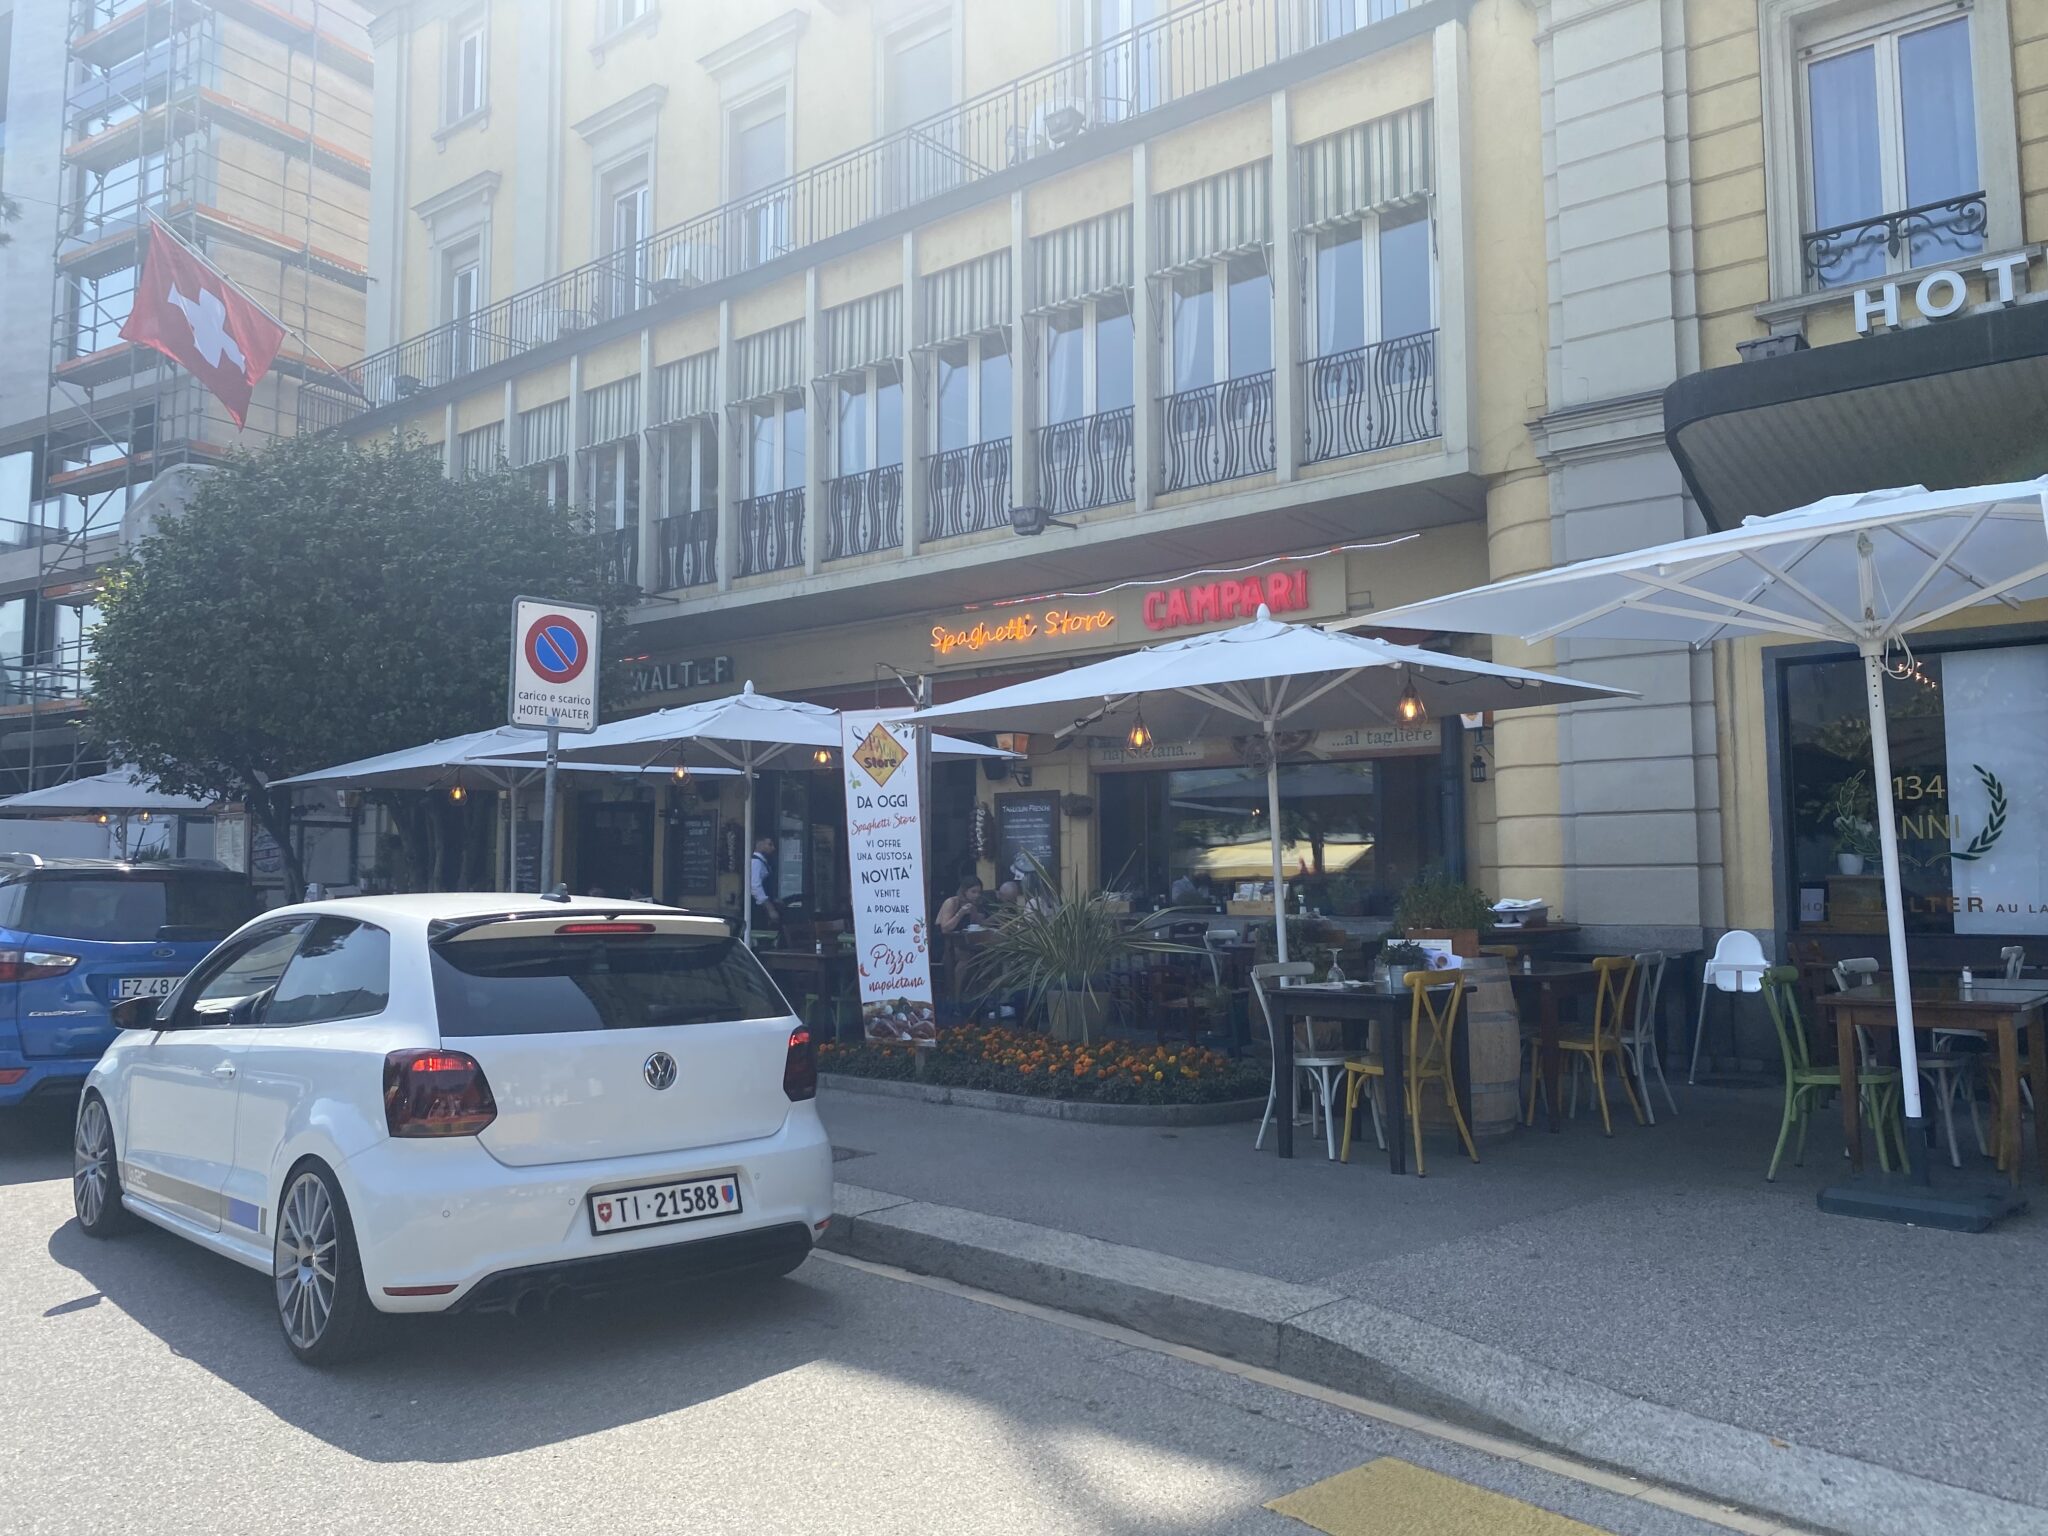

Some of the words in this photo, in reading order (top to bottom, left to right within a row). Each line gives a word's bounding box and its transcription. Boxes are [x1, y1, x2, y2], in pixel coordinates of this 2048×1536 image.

[1854, 248, 2048, 335] HOT
[1143, 569, 1309, 631] CAMPARI
[930, 613, 1037, 654] Spaghetti
[1044, 609, 1115, 635] Store
[518, 691, 547, 702] carico
[549, 694, 556, 703] e
[558, 695, 591, 705] scarico
[519, 705, 549, 716] HOTEL
[551, 707, 589, 719] WALTER
[1366, 727, 1433, 746] tagliere
[863, 756, 897, 769] Store
[1893, 775, 1946, 800] 134
[857, 795, 873, 808] DA
[877, 794, 908, 808] OGGI
[851, 818, 891, 836] Spaghetti
[892, 812, 917, 829] Store
[1879, 815, 1960, 840] NNI
[866, 840, 875, 848] VI
[877, 839, 902, 848] OFFRE
[857, 852, 873, 861] UNA
[875, 851, 913, 861] GUSTOSA
[861, 864, 912, 884] NOVITA'
[874, 889, 900, 898] VENITE
[866, 905, 872, 913] A
[874, 904, 910, 913] PROVARE
[1995, 903, 2018, 913] AU
[885, 920, 906, 936] Vera
[870, 943, 916, 975] Pizza
[121, 979, 143, 995] FZ
[868, 977, 925, 995] napoletana
